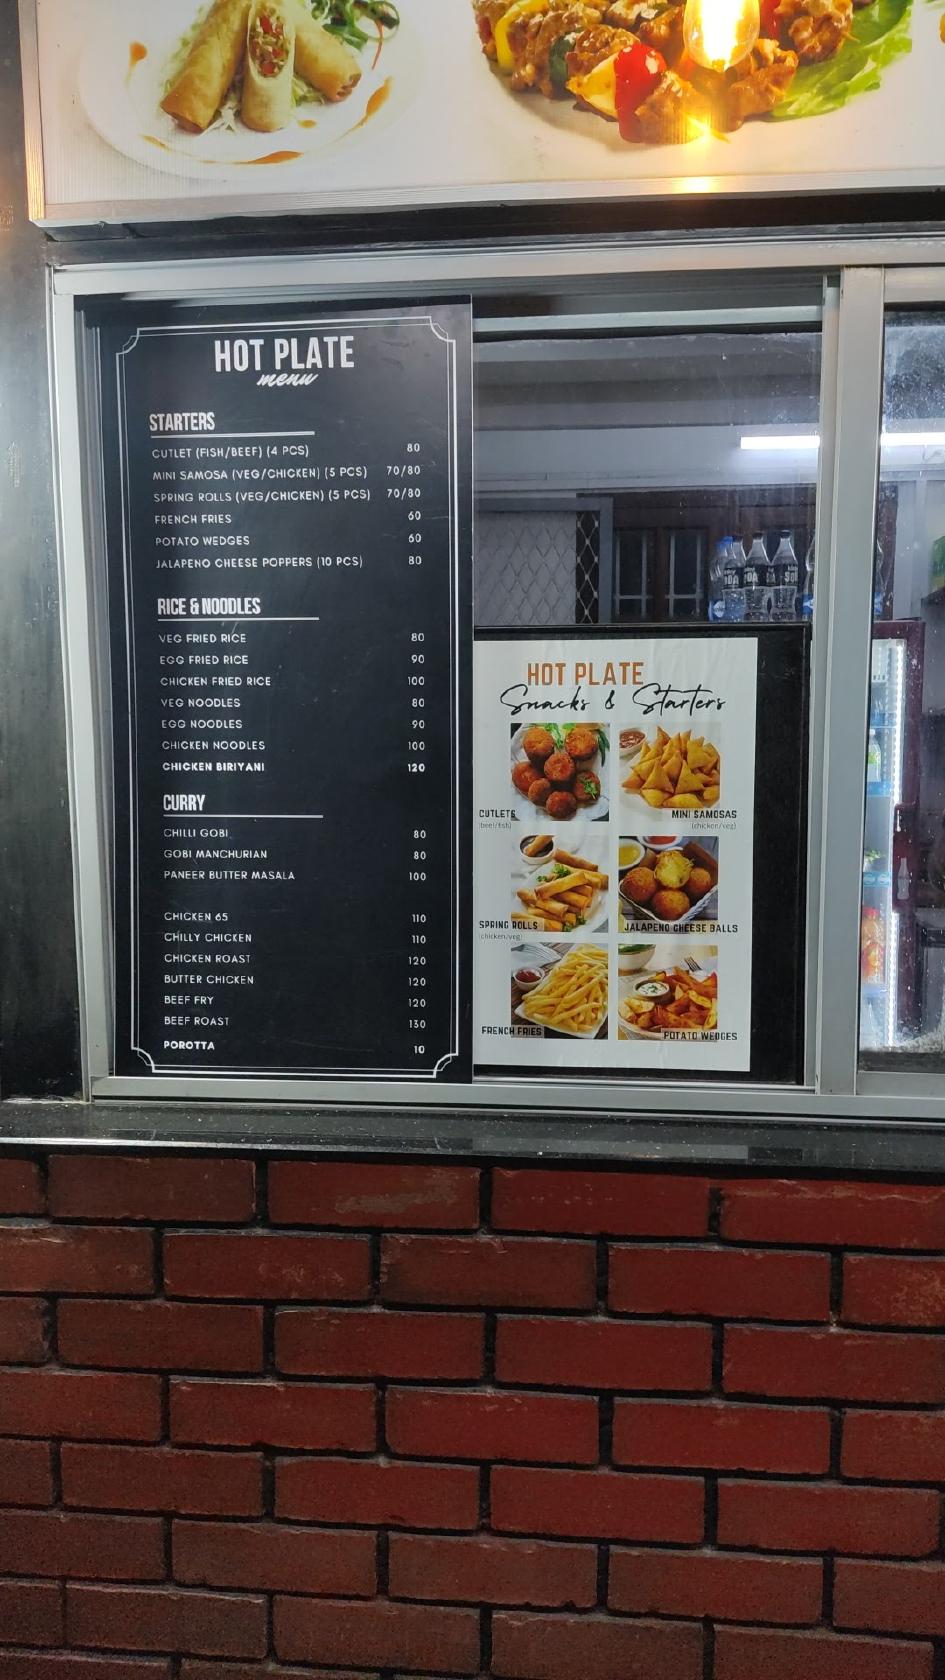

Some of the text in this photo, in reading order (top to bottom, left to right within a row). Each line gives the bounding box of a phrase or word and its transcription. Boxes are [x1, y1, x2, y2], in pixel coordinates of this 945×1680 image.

[215, 336, 354, 372] HOT PLATE
[256, 372, 319, 386] menu
[150, 412, 215, 431] STARTERS
[152, 445, 308, 459] CUTLET (FISH/BEEF) (4 PCS)
[407, 443, 420, 452] 80
[153, 466, 367, 480] MINI SAMOSA (VEG/CHICKEN) (5 PCS)
[387, 465, 420, 477] 70/80
[154, 489, 370, 503] SPRING ROLLS (VEG/CHICKEN) (5 PCS)
[387, 488, 420, 500] 70/80
[155, 514, 231, 524] FRENCH FRIES
[408, 511, 421, 520] 60
[156, 536, 249, 546] POTATO WEDGES
[409, 533, 421, 543] 60
[157, 556, 362, 568] JALAPENO CHEESE POPPERS (10 PCS)
[409, 556, 421, 564] 80
[158, 598, 260, 615] RICE & NOODLES
[159, 634, 246, 643] VEG FRIED RICE
[411, 633, 424, 641] 80
[160, 655, 248, 664] EGG FRIED RICE
[412, 655, 424, 663] 90
[528, 662, 644, 686] HOT PLATE
[160, 677, 270, 686] CHICKEN FRIED RICE
[408, 676, 424, 685] 100
[161, 698, 240, 707] VEG NOODLES
[412, 698, 424, 707] 80
[500, 682, 726, 716] Snacks & Starters
[162, 720, 242, 728] EGG NOODLES
[412, 720, 424, 728] 90
[162, 741, 265, 750] CHICKEN NOODLES
[409, 742, 425, 750] 100
[163, 762, 264, 771] CHICKEN BIRIYANI
[408, 763, 425, 772] 120
[164, 794, 205, 811] CURRY
[479, 809, 516, 818] CUTLETS
[672, 810, 737, 819] MINI SAMOSAS
[164, 829, 228, 837] CHILLI GOBI
[414, 830, 426, 838] 80
[164, 850, 267, 858] GOBI MANCHURIAN
[414, 851, 426, 859] 80
[165, 871, 295, 879] PANEER BUTTER MASALA
[410, 872, 426, 881] 100
[165, 912, 228, 921] CHICKEN 65
[413, 914, 426, 922] 110
[479, 920, 538, 930] SPRING ROLLS
[624, 923, 738, 933] JALAPENO CHEESE BALLS
[165, 933, 251, 942] CHILLY CHICKEN
[412, 935, 426, 943] 110
[165, 954, 250, 963] CHICKEN ROAST
[409, 957, 426, 965] 120
[165, 975, 253, 984] BUTTER CHICKEN
[409, 978, 426, 986] 120
[165, 996, 213, 1004] BEEF FRY
[409, 999, 425, 1007] 120
[165, 1016, 228, 1025] BEEF ROAST
[410, 1020, 425, 1028] 130
[482, 1026, 542, 1036] FRENCH FRIES
[664, 1031, 738, 1041] POTATO WEDGES
[164, 1041, 214, 1050] POROTTA
